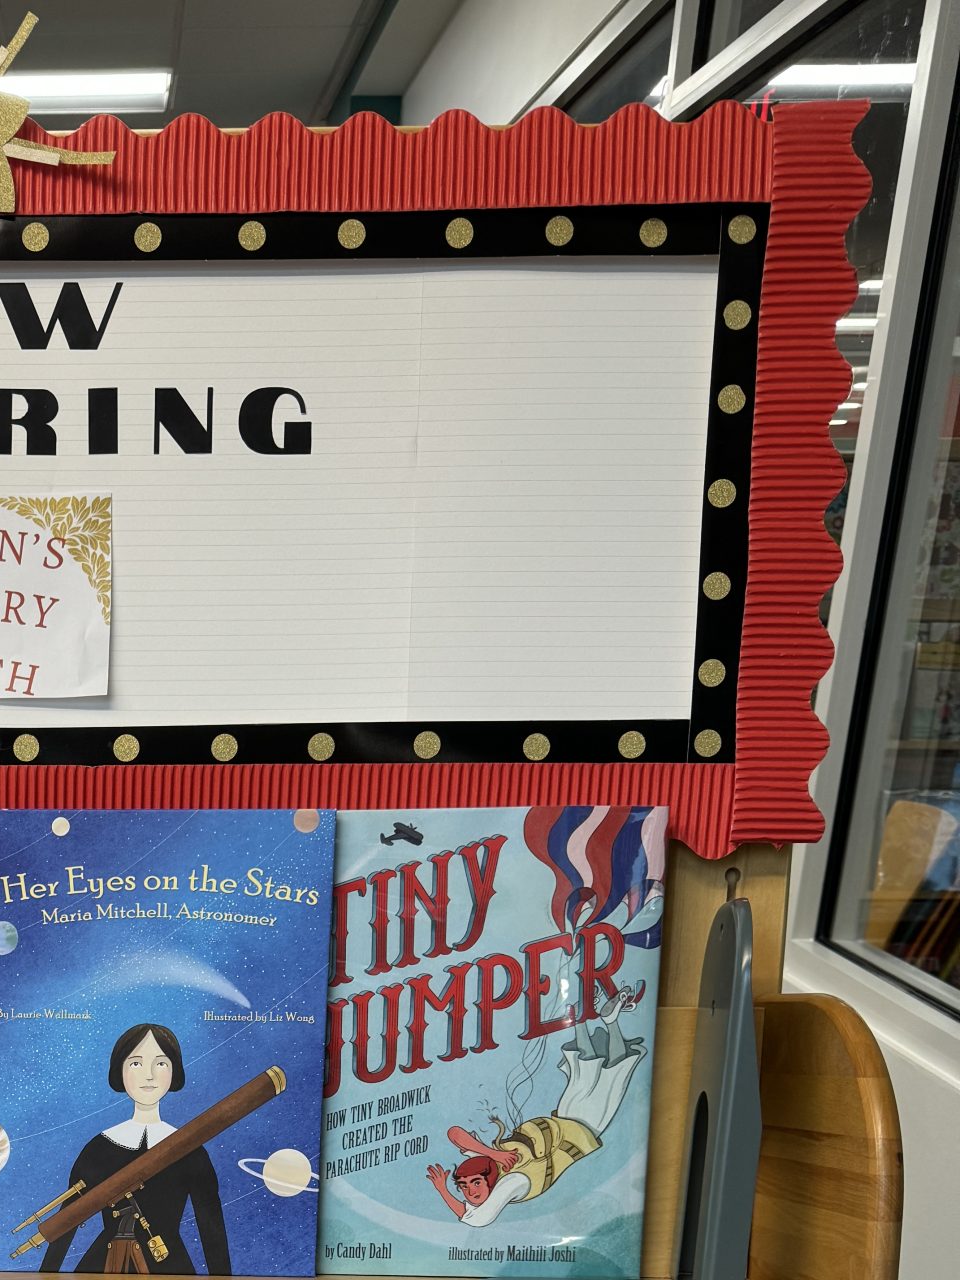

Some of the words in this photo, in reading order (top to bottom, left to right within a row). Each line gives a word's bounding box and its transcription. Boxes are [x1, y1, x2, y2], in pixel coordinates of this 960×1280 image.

[1, 873, 59, 903] Her
[65, 866, 135, 898] Eyes
[144, 875, 179, 890] on
[189, 865, 237, 893] the
[244, 868, 319, 905] Stars
[41, 909, 92, 925] Maria
[96, 903, 172, 920] Mitchell,
[176, 903, 277, 926] Astronomer
[329, 834, 508, 987] TINY
[11, 1009, 41, 1019] Laurie
[269, 1012, 283, 1022] Liz
[286, 1012, 315, 1024] Wong
[326, 1113, 347, 1132] HOW
[351, 1105, 373, 1124] TINY
[377, 1085, 432, 1118] BROADWICK
[342, 1124, 388, 1150] CREATED
[392, 1115, 413, 1134] THE
[325, 1151, 381, 1180] PARACHUTE
[384, 1146, 400, 1163] RIP
[403, 1135, 429, 1157] CORD
[337, 1243, 366, 1260] Candy
[369, 1243, 392, 1259] Dahl
[448, 1246, 492, 1261] illustrated
[507, 1246, 546, 1262] Maithili
[548, 1247, 576, 1262] Joshi
